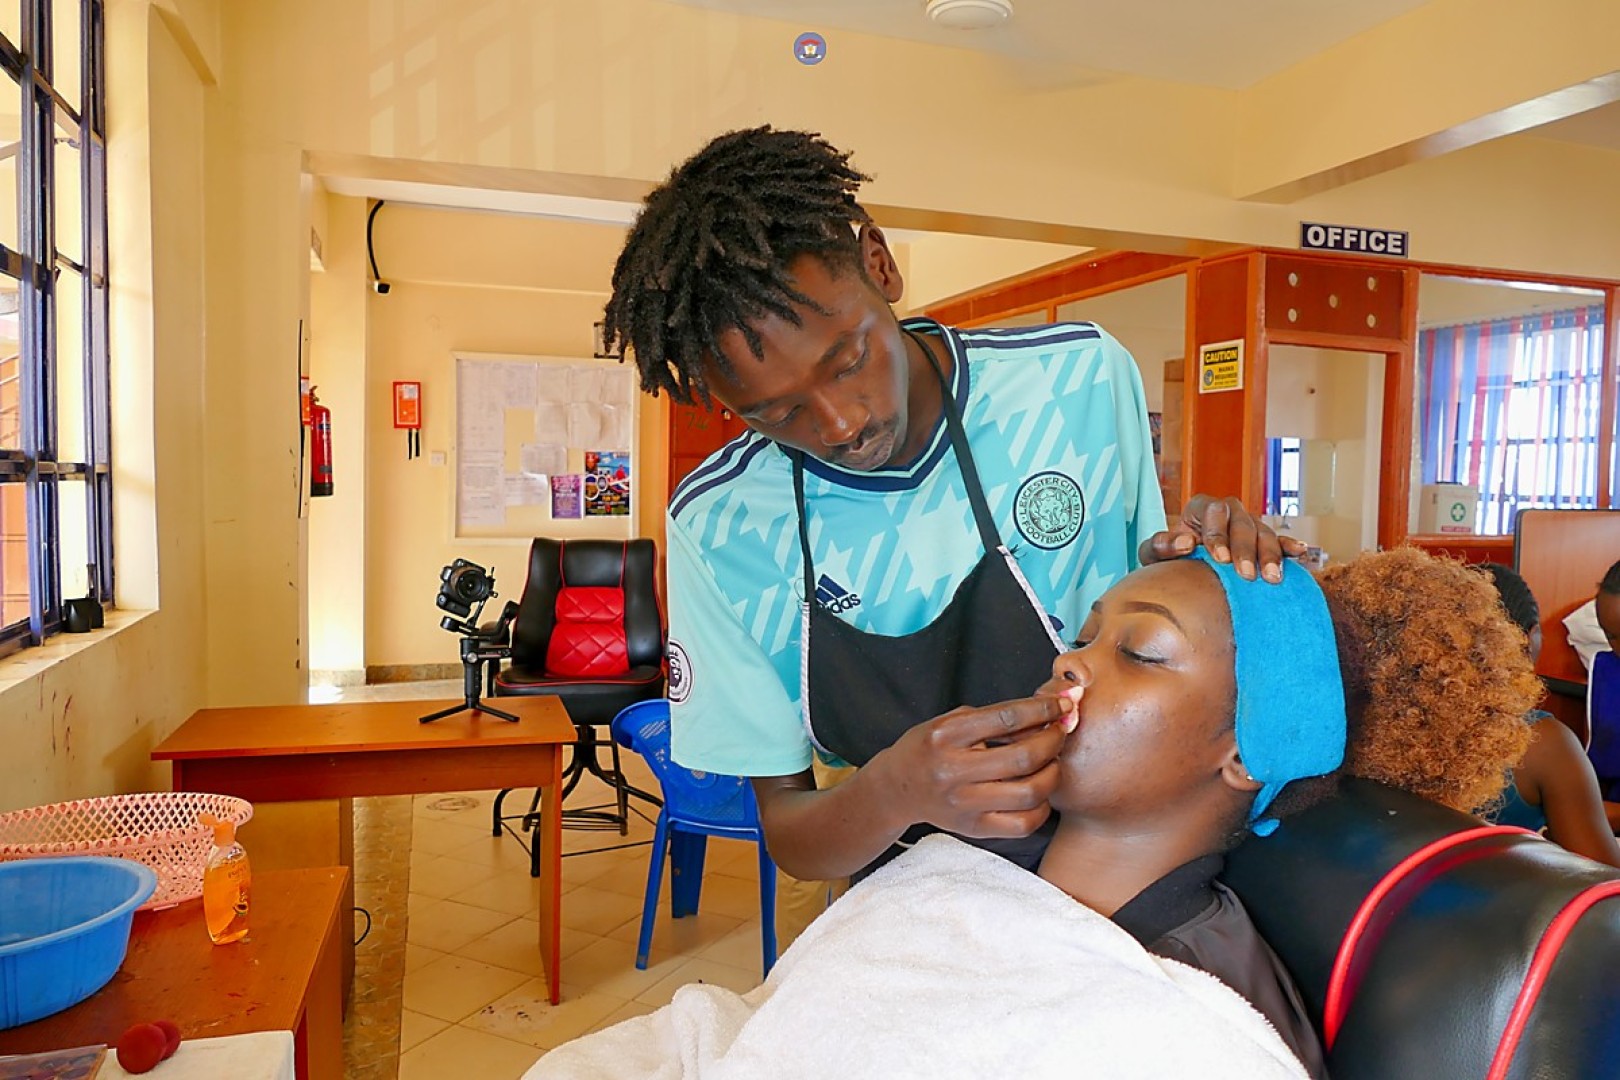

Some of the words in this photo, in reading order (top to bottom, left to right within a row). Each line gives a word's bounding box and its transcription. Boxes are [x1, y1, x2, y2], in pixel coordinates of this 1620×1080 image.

[1307, 225, 1402, 254] OFFICE
[1205, 349, 1238, 363] CAUTION
[1019, 477, 1060, 515] LEICESTER
[1060, 480, 1078, 498] CITY
[1022, 520, 1071, 544] FOOTBALL
[1069, 503, 1081, 532] CLUB
